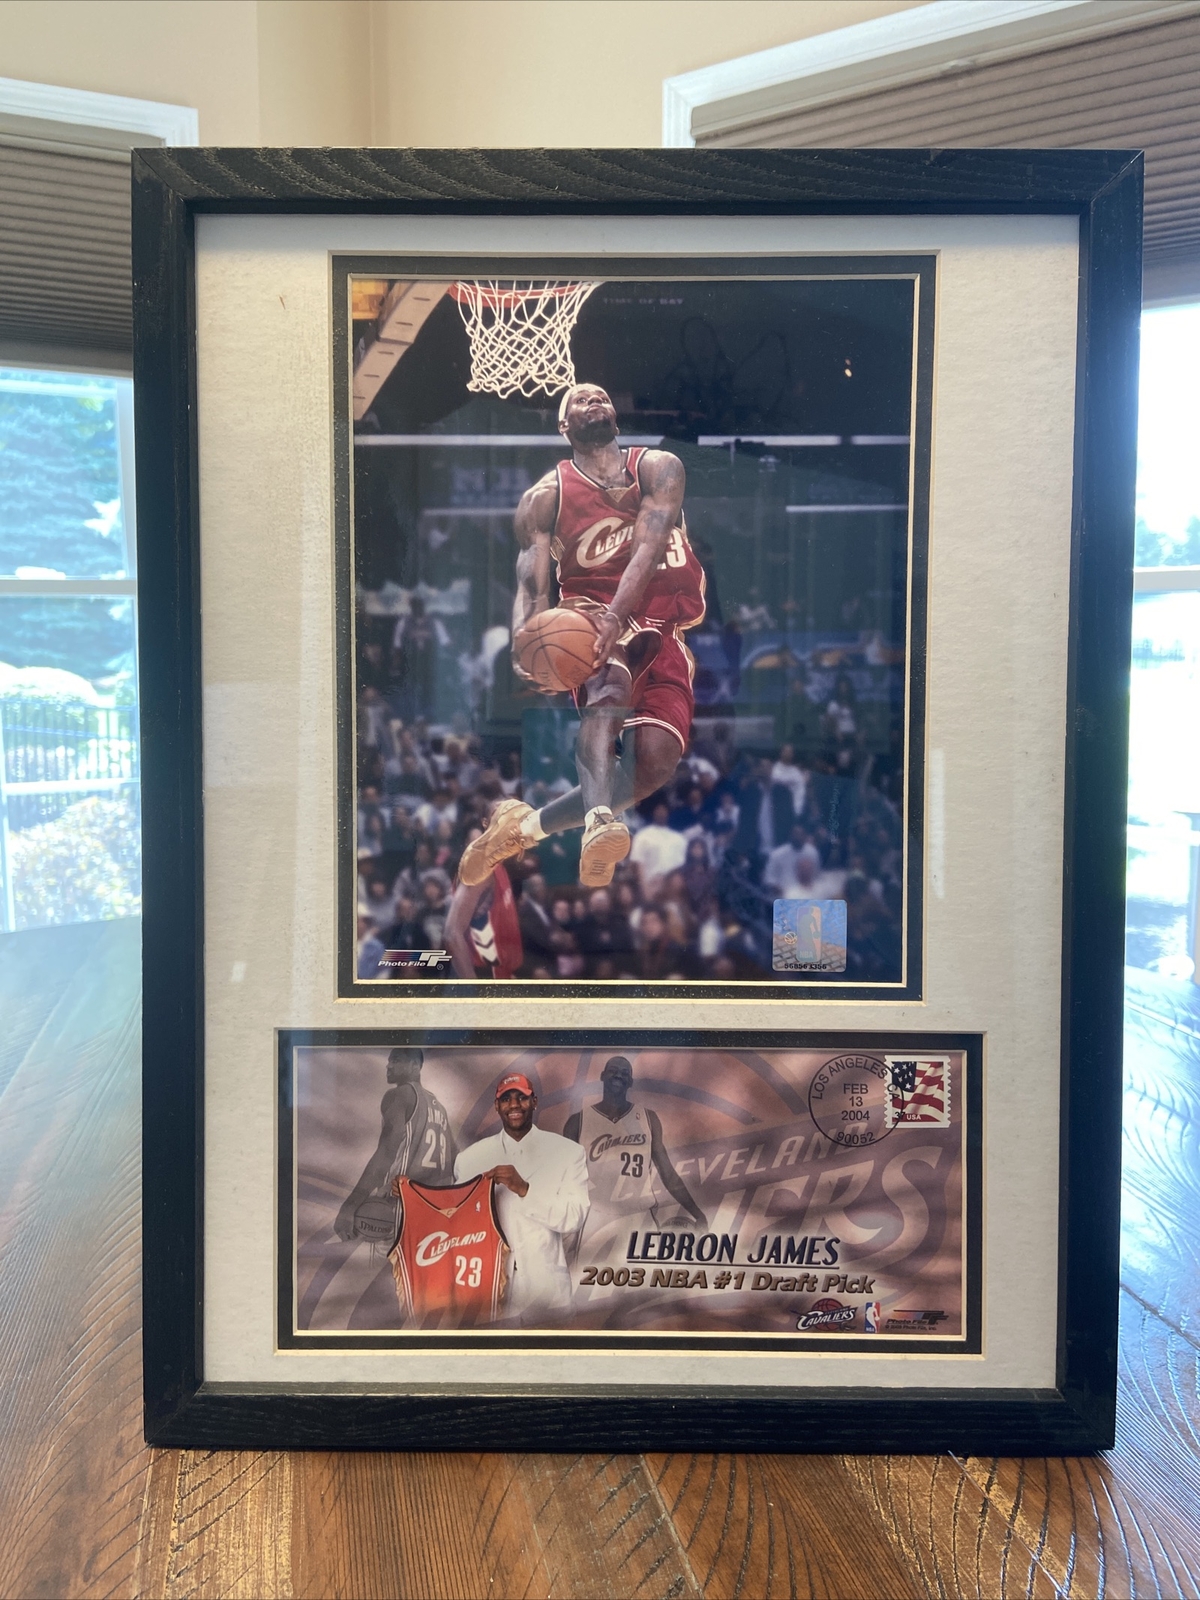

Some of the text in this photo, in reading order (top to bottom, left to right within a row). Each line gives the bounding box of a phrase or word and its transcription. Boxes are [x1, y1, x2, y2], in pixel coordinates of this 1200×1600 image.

[812, 1073, 829, 1100] LOS
[828, 1057, 888, 1080] ANGELES
[843, 1083, 868, 1094] FEB
[849, 1096, 863, 1107] 13
[841, 1110, 870, 1121] 2004
[421, 1128, 447, 1171] 23
[589, 1133, 647, 1162] CAVALIERS
[836, 1131, 875, 1145] 90052
[620, 1151, 644, 1178] 23
[415, 1231, 487, 1267] CLEVELAND
[626, 1231, 841, 1265] LEBRON JAMES
[455, 1255, 483, 1288] 23
[580, 1266, 876, 1293] 2003 NBA #1 Draft Pick
[797, 1309, 855, 1331] CAVALIERS
